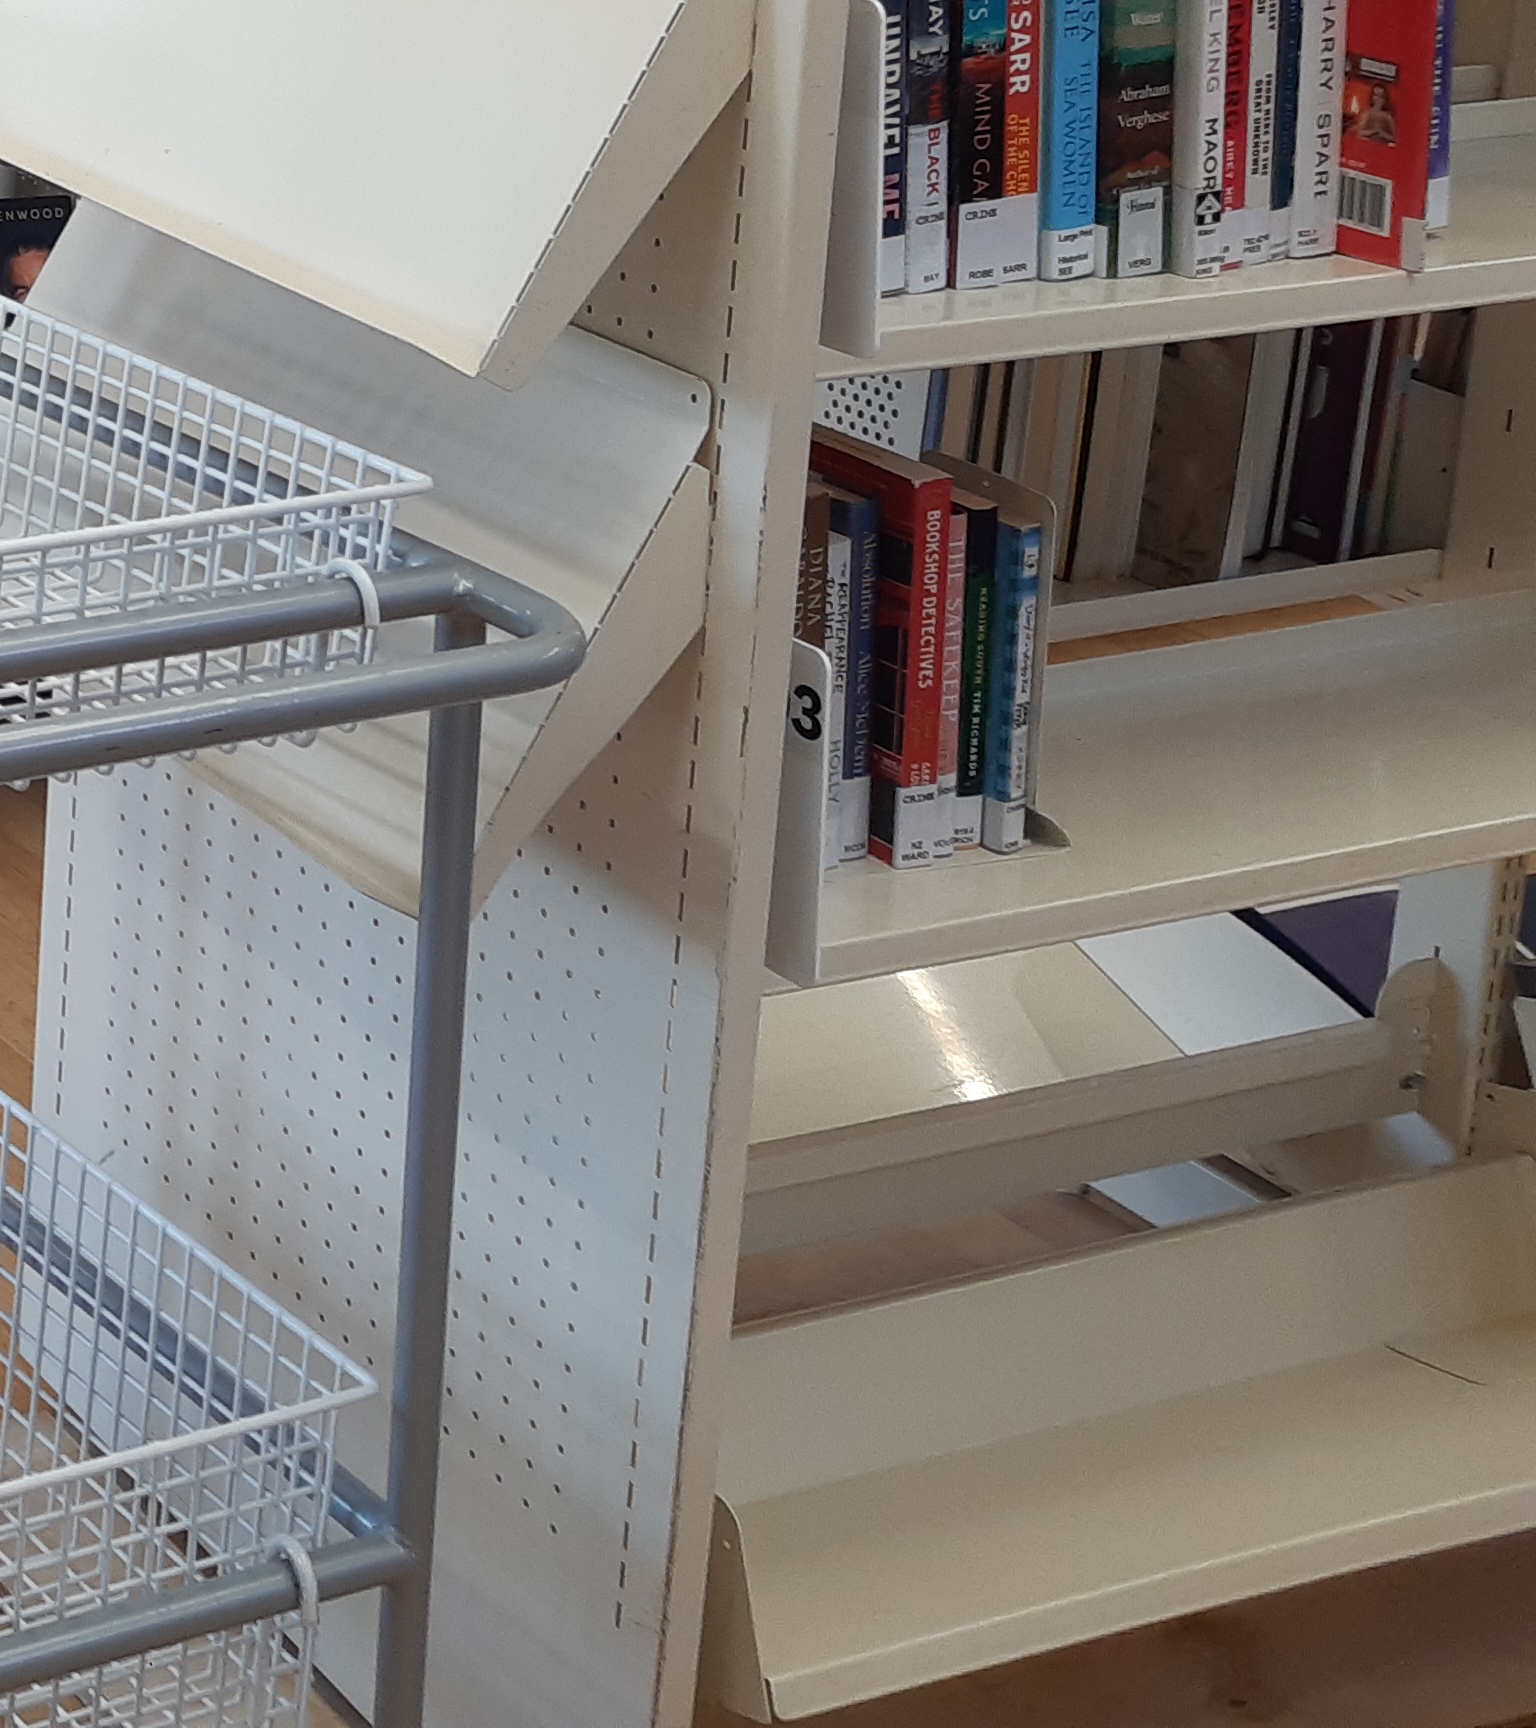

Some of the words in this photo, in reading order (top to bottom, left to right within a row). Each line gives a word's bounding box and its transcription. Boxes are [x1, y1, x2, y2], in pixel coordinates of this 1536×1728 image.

[1008, 10, 1033, 96] SARR
[1079, 61, 1093, 95] THE
[1205, 31, 1222, 94] KING
[973, 82, 993, 151] MIND
[1063, 76, 1078, 113] SEA
[1116, 109, 1171, 130] Verghese
[1118, 82, 1171, 104] Abraham
[925, 126, 941, 195] BLACK
[1018, 116, 1031, 146] THE
[1076, 105, 1093, 184] ISLAND
[1202, 117, 1220, 191] MAOR
[971, 159, 992, 202] GA
[1062, 120, 1077, 208] WOMEN
[964, 208, 998, 221] CRIME
[968, 268, 995, 281] ROBE
[923, 508, 942, 595] BOOKSHOP
[946, 538, 966, 591] THE
[807, 547, 824, 627] DIANA
[831, 582, 850, 695] REAPPEARANCE
[916, 596, 938, 690] DETECTIVES
[941, 598, 963, 723] SAFEKEEP
[791, 684, 822, 741] 3
[828, 738, 843, 804] HOLLY
[901, 791, 935, 804] CRIME
[901, 851, 930, 862] WARD
